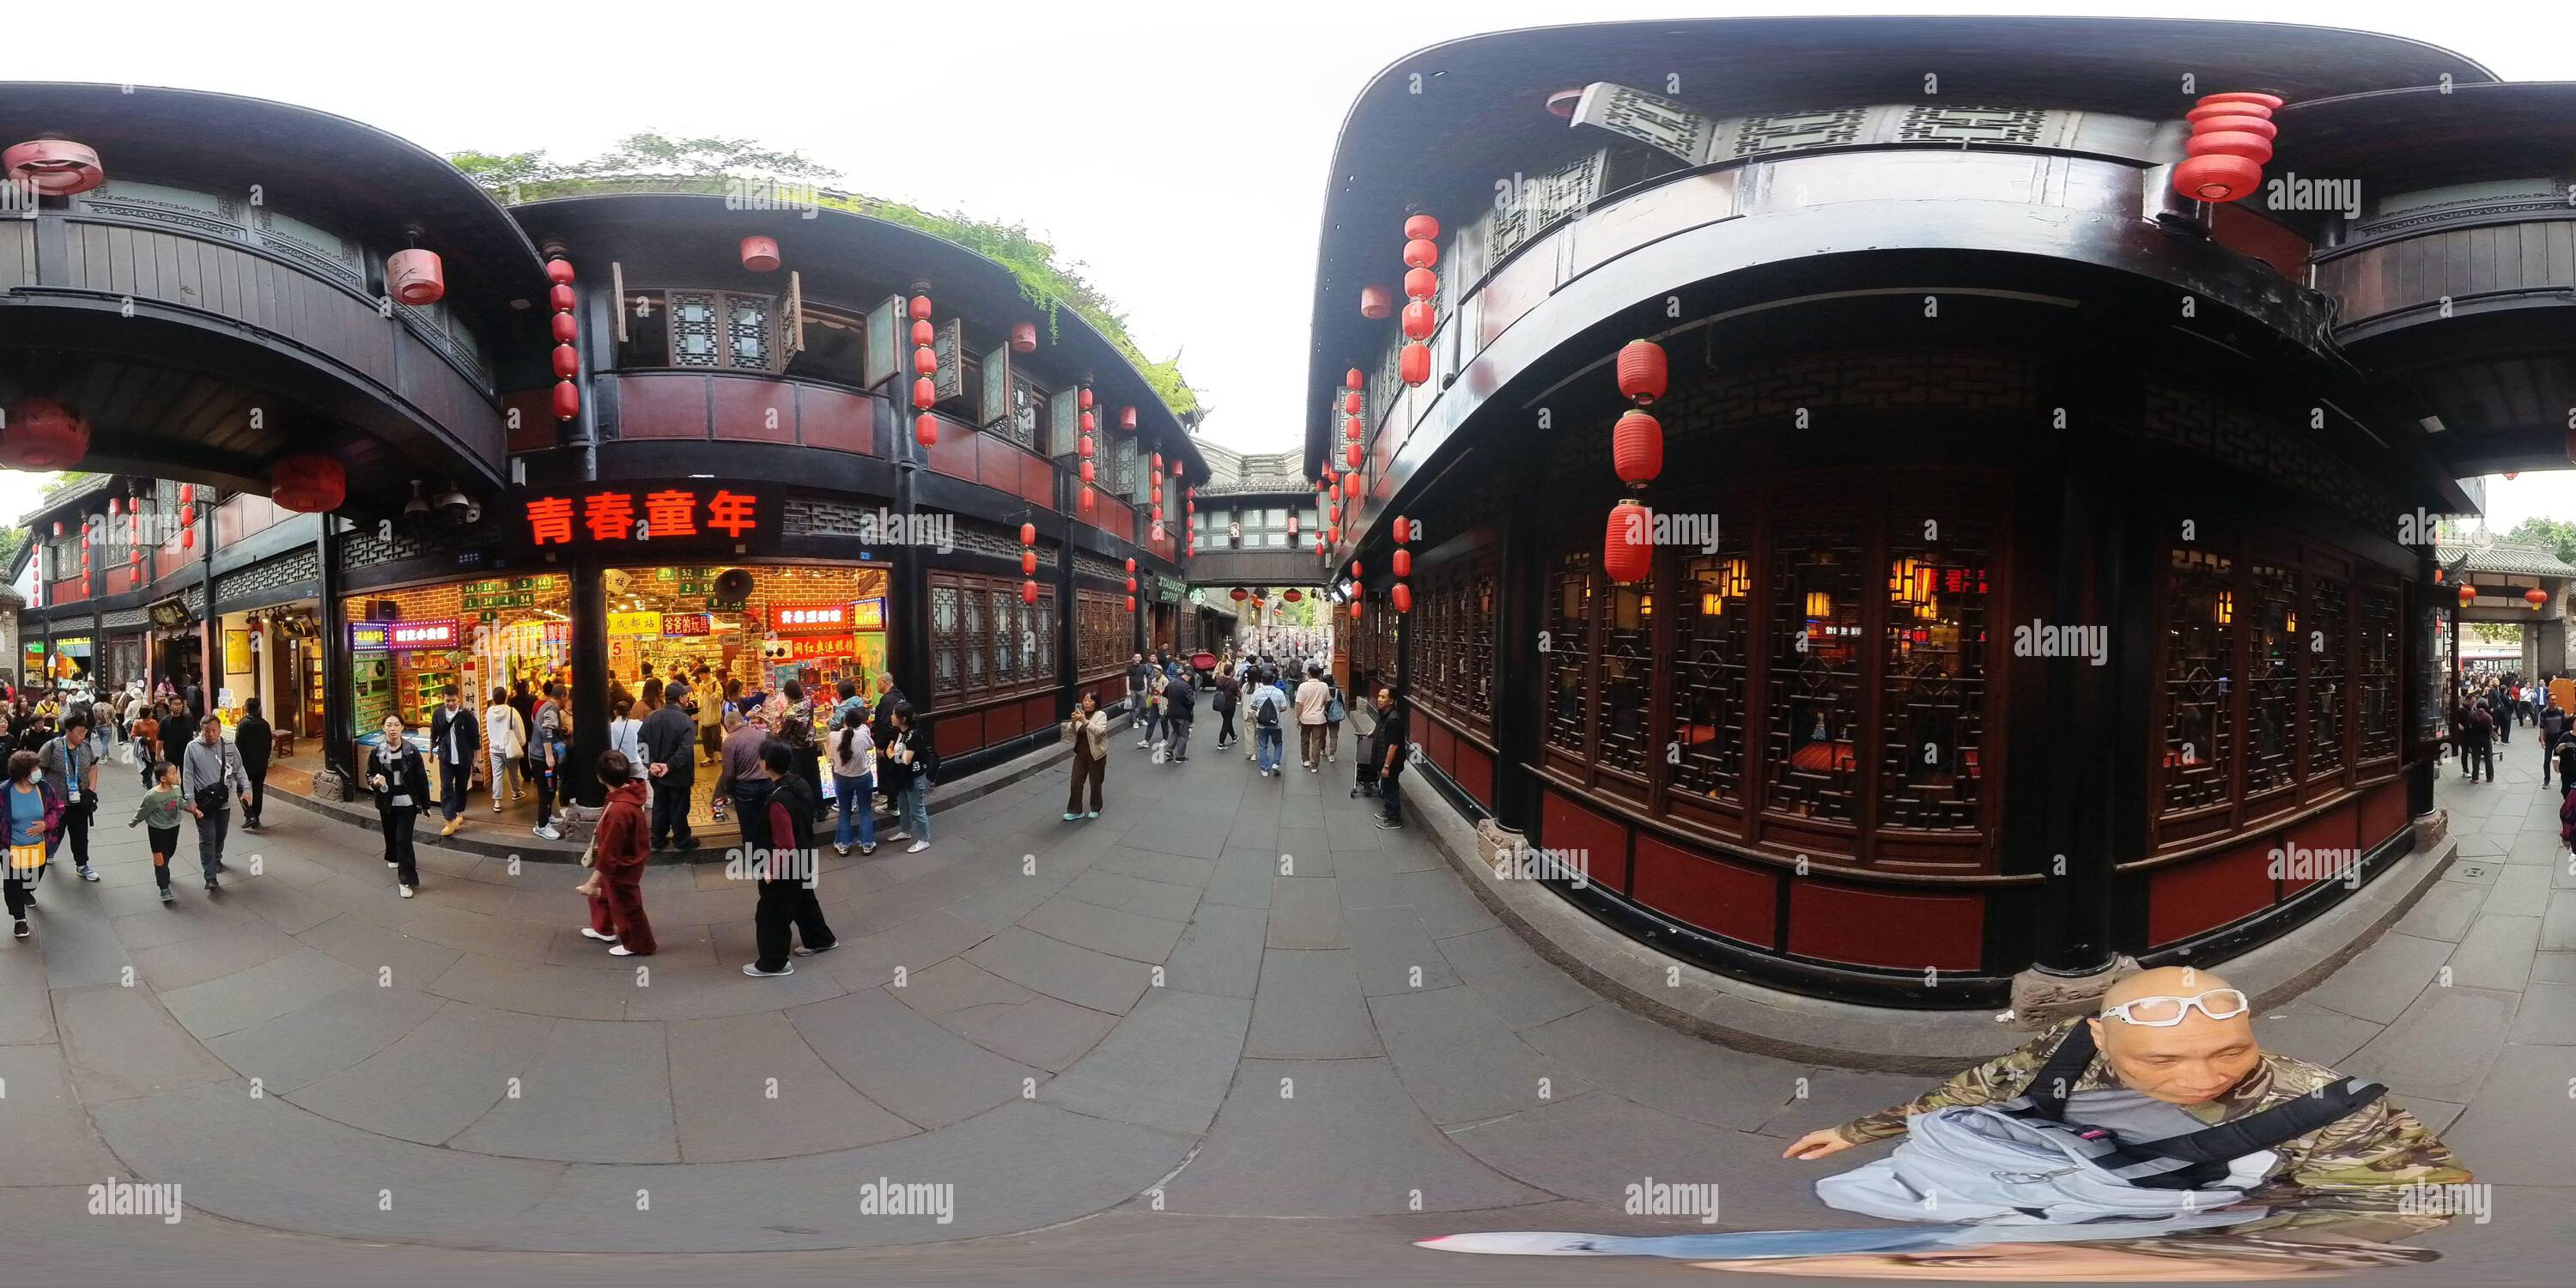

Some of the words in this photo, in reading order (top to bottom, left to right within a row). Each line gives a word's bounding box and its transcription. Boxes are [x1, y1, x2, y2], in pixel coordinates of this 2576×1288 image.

[526, 490, 756, 545] 青春童年
[617, 617, 654, 630] 成都站
[665, 616, 708, 634] 爸爸的玩具
[612, 642, 622, 655] 5
